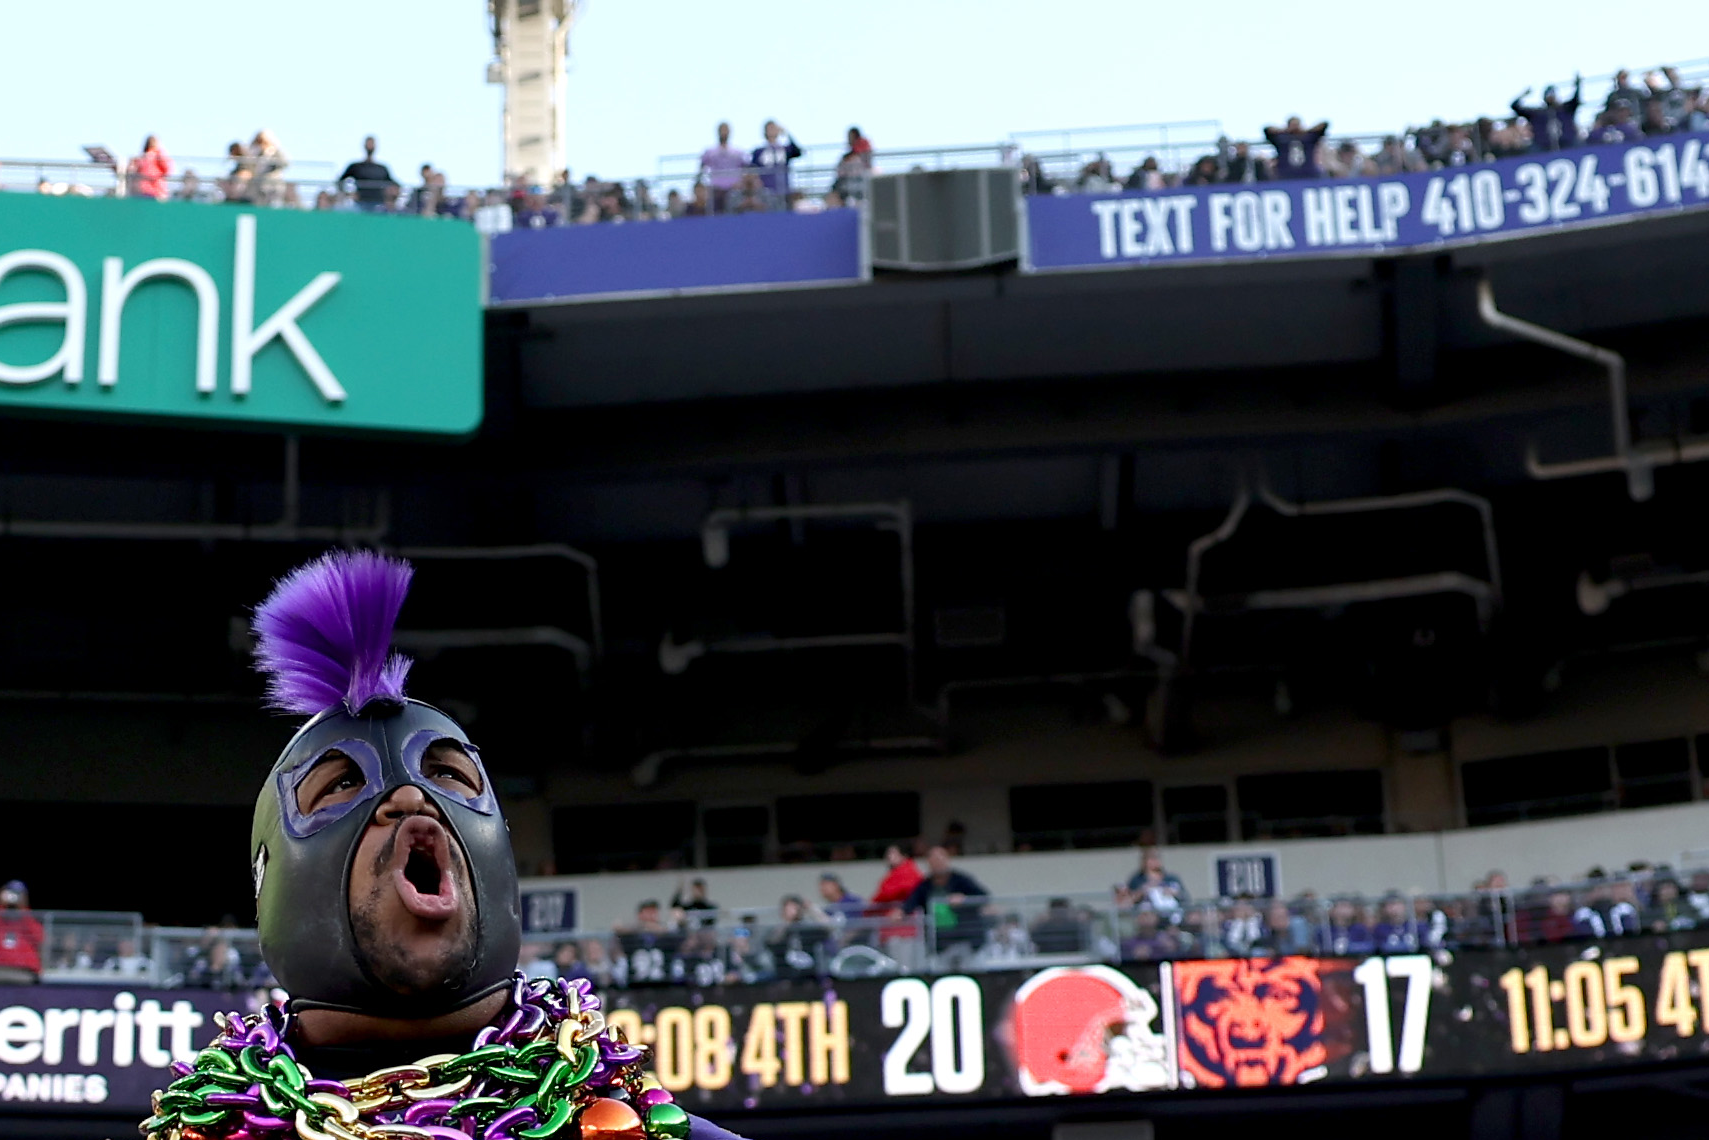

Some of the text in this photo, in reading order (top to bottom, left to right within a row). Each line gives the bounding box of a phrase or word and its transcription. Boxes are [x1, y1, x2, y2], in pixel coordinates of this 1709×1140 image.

[1091, 138, 1709, 259] TEXT FOR HELP 410-324-614
[740, 1000, 851, 1088] 4TH
[881, 975, 986, 1096] 20
[1354, 955, 1434, 1075] 17
[1499, 955, 1647, 1054] 11:05
